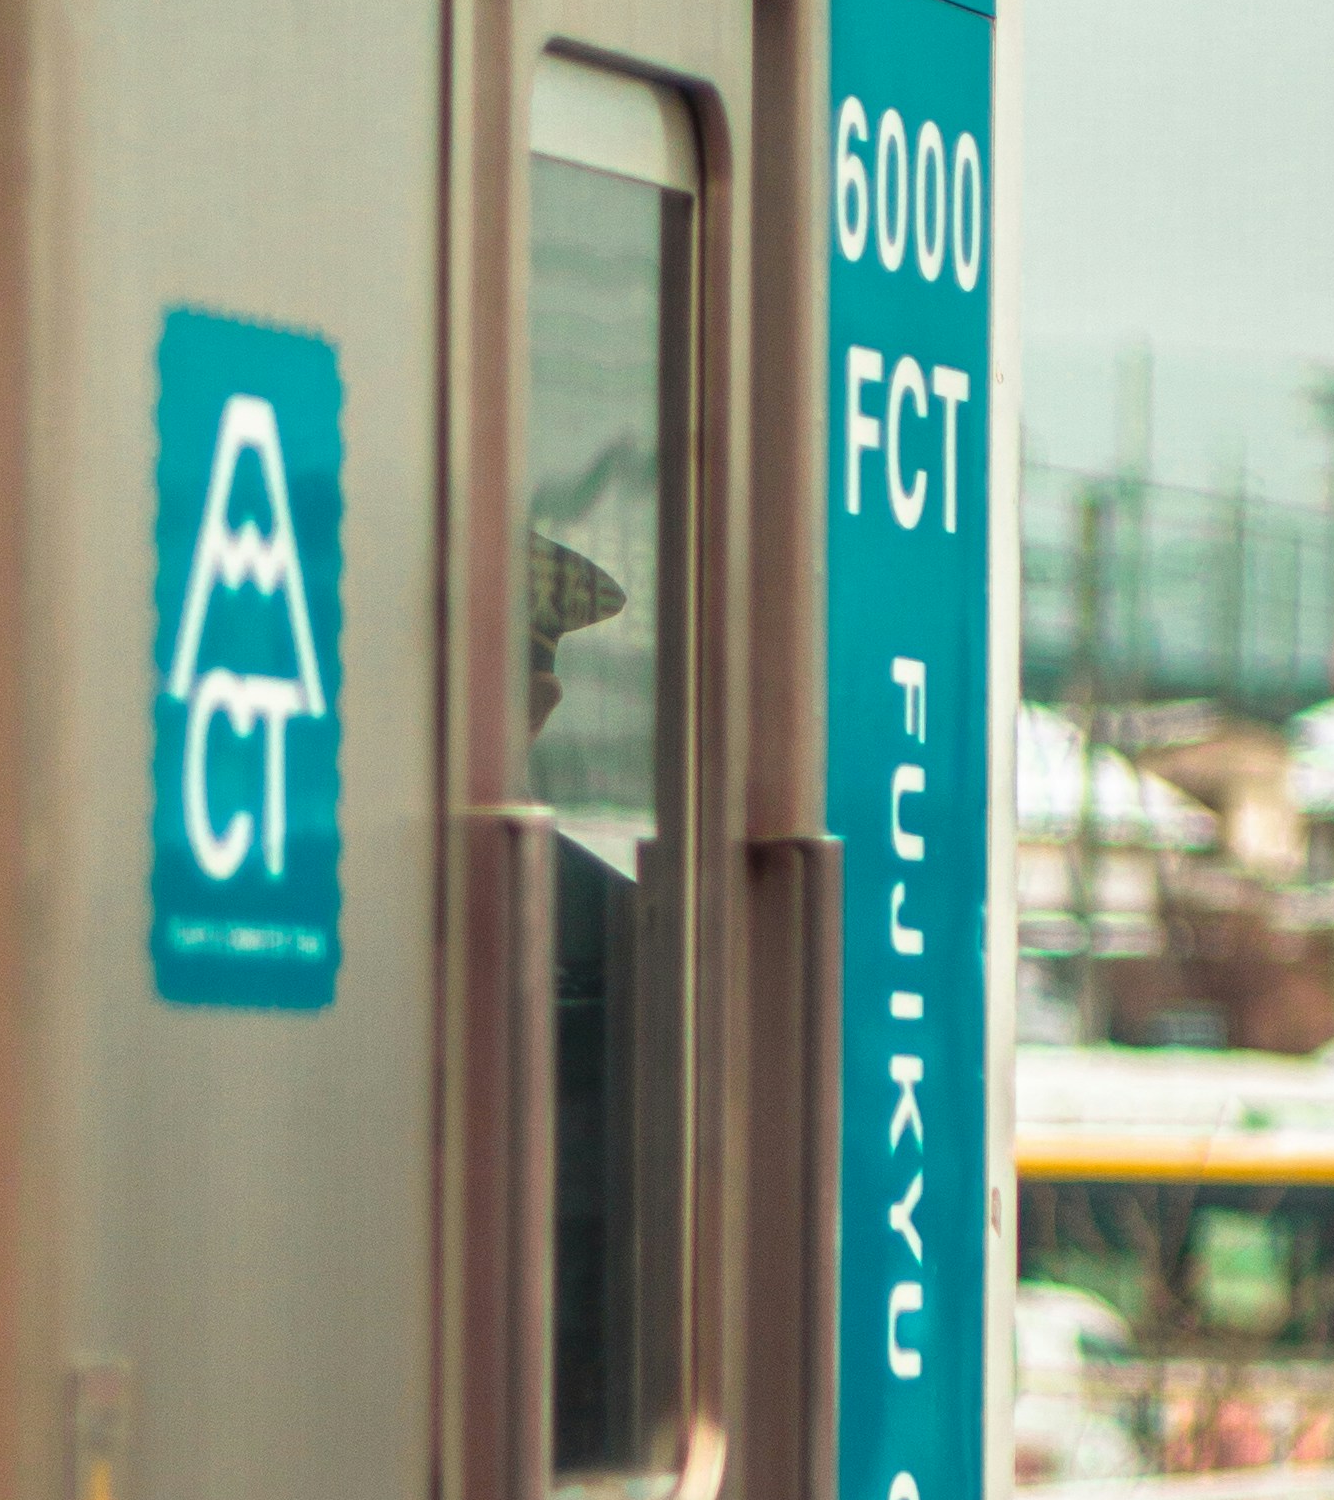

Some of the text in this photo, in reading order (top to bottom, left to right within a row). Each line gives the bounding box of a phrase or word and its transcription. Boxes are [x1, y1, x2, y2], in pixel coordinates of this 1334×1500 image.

[833, 94, 983, 293] 6000
[845, 344, 971, 534] FCT
[886, 654, 927, 1383] FUJIKYU
